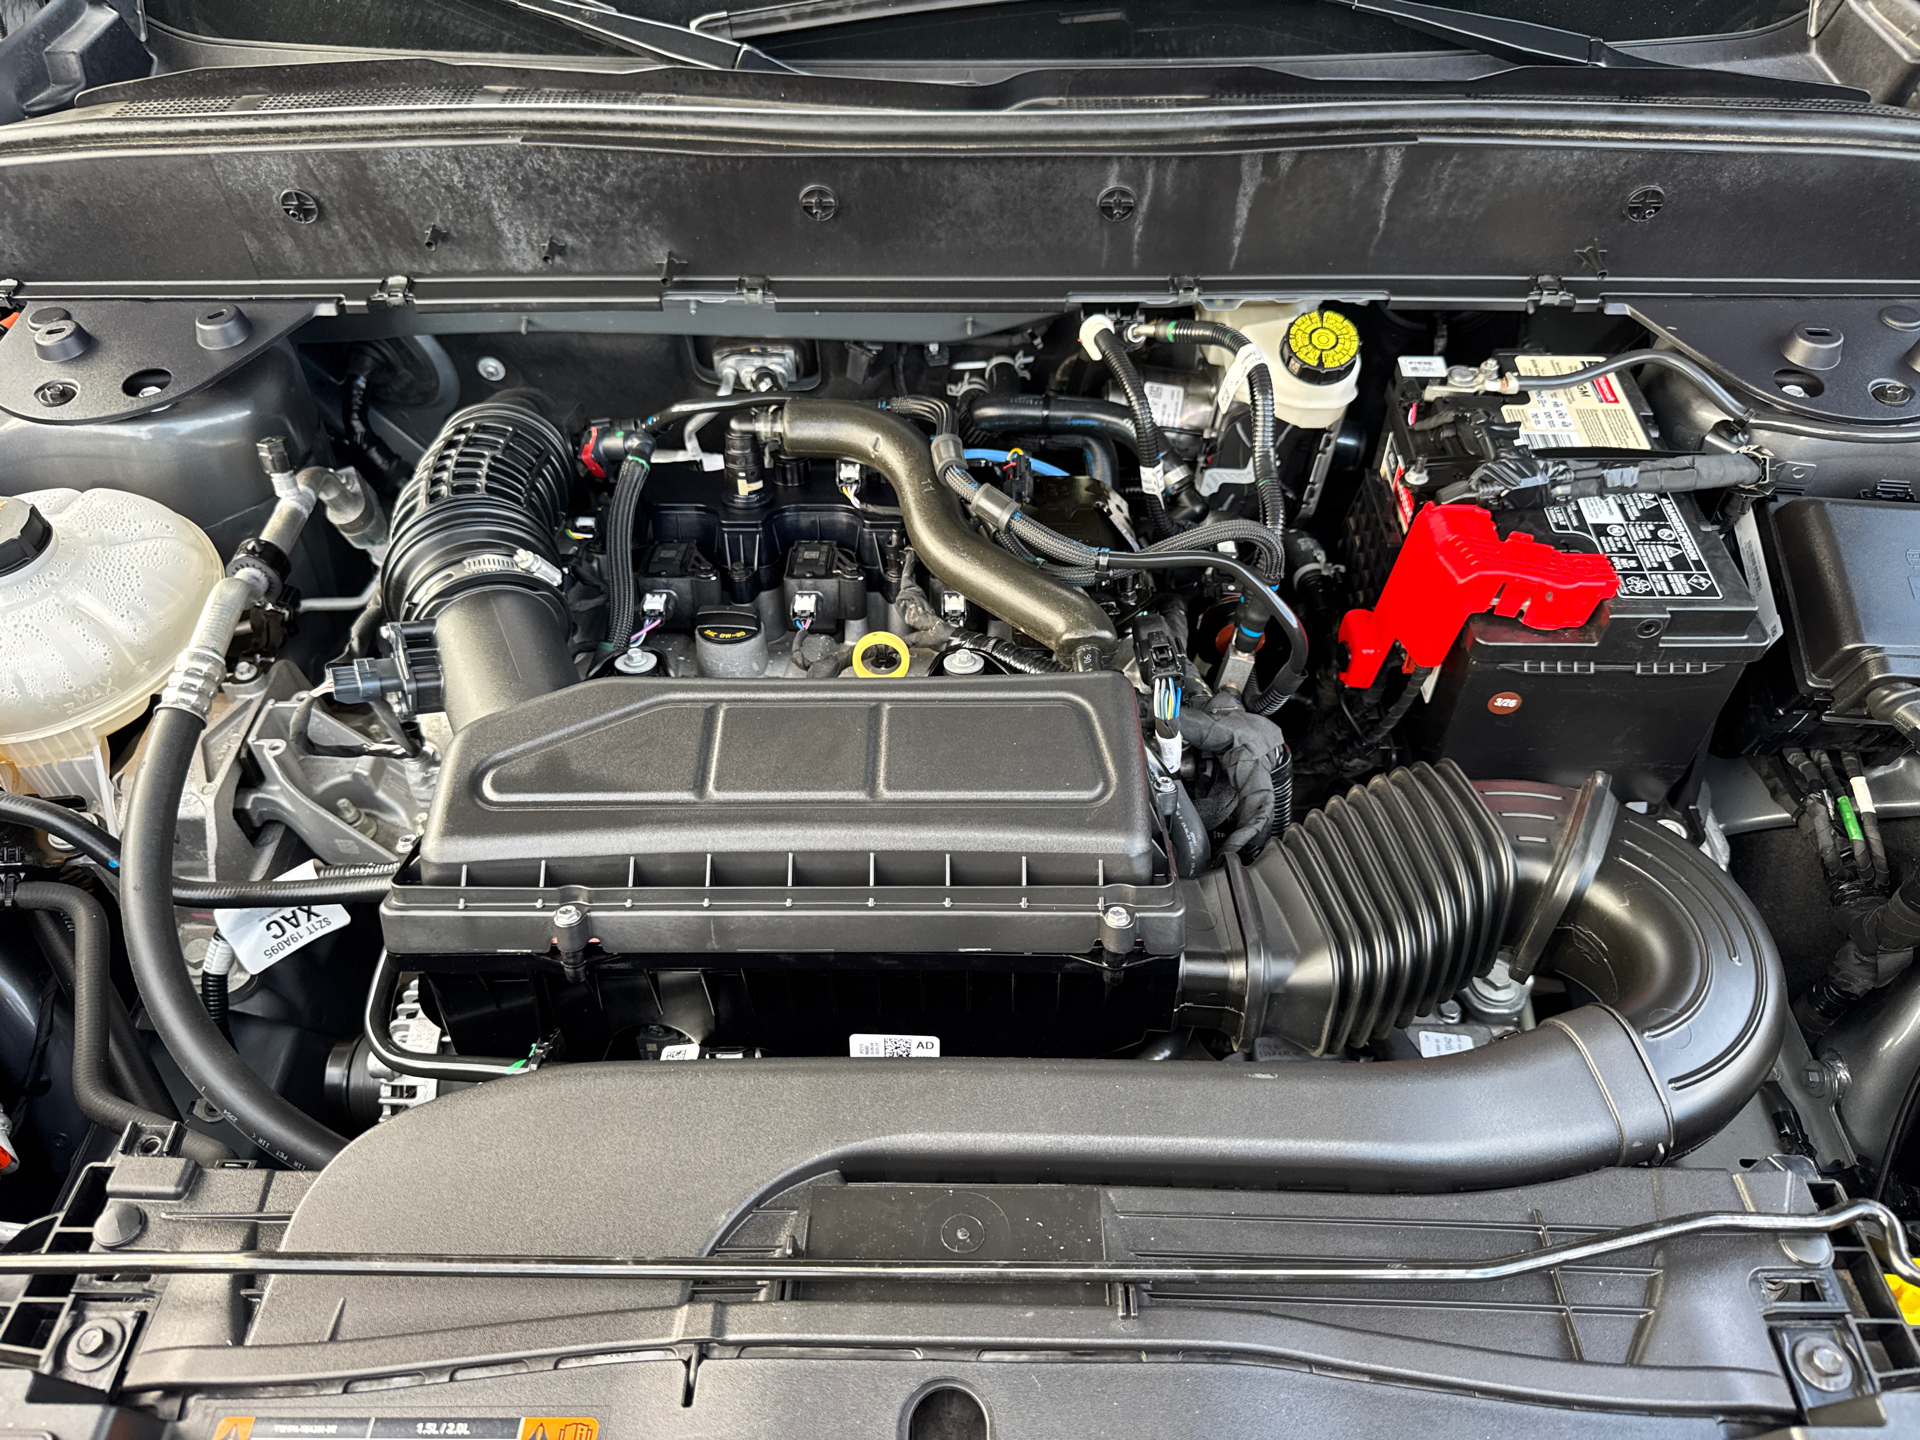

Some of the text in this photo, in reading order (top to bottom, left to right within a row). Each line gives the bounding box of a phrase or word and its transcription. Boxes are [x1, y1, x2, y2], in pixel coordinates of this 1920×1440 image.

[1662, 503, 1700, 560] DANGER/POISON
[704, 629, 746, 639] SAE 0W-20
[1493, 697, 1518, 708] 3/26
[265, 905, 322, 940] XAC
[263, 917, 332, 960] SZ1T 19A095
[915, 1041, 935, 1050] AD
